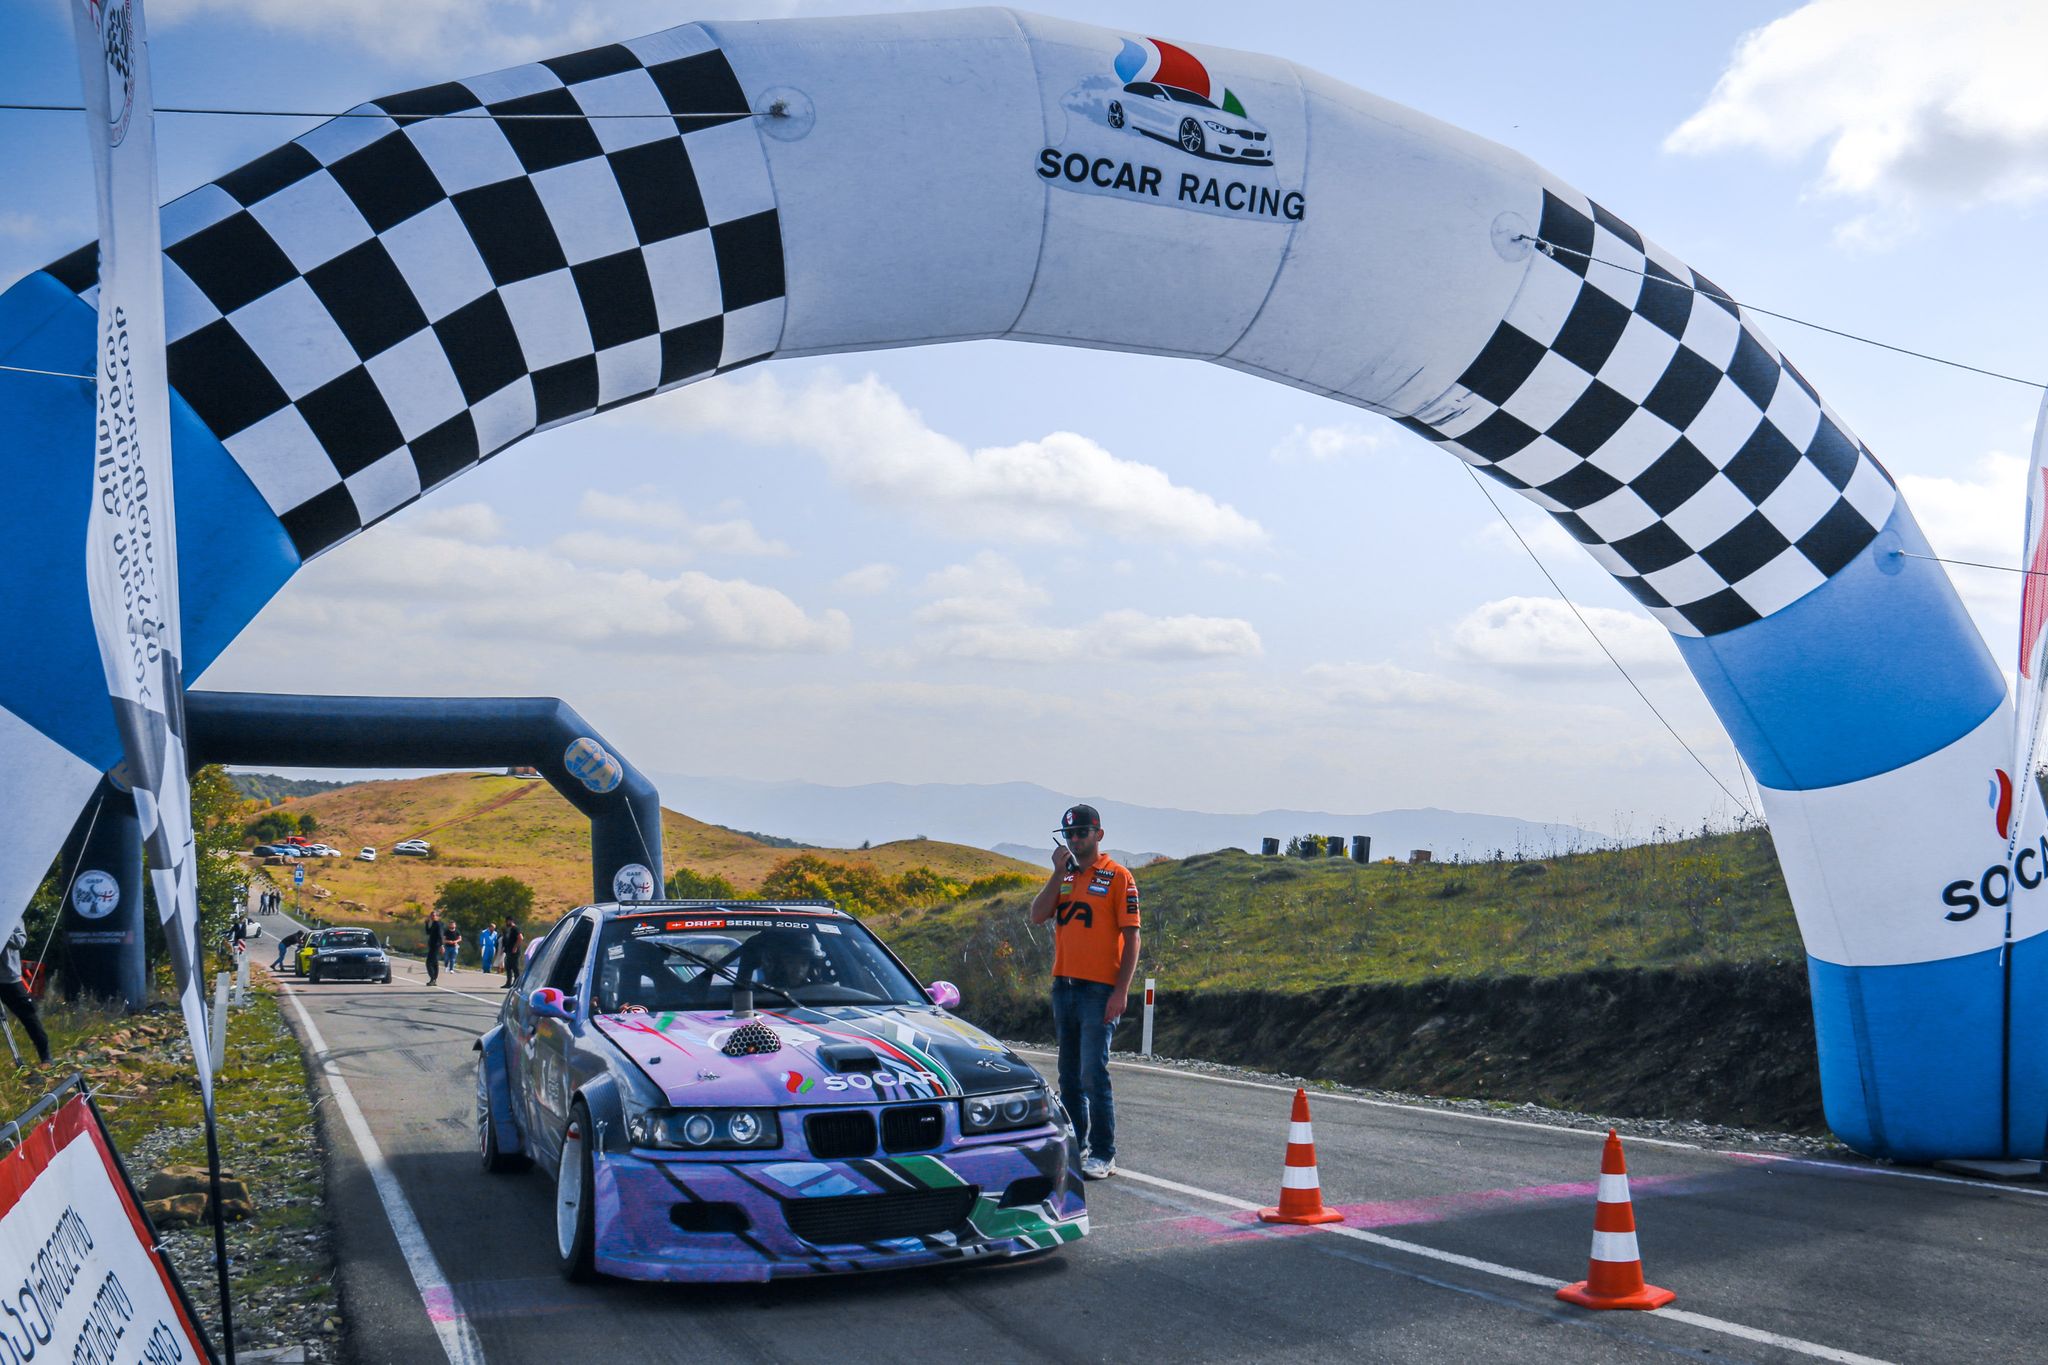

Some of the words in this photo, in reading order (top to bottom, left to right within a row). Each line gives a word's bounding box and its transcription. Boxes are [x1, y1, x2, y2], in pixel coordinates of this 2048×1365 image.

[1037, 148, 1162, 197] SOCAR
[1178, 173, 1305, 221] RACING
[684, 920, 723, 928] DRIFT
[776, 921, 809, 929] 2020
[823, 1071, 943, 1091] SOCAR
